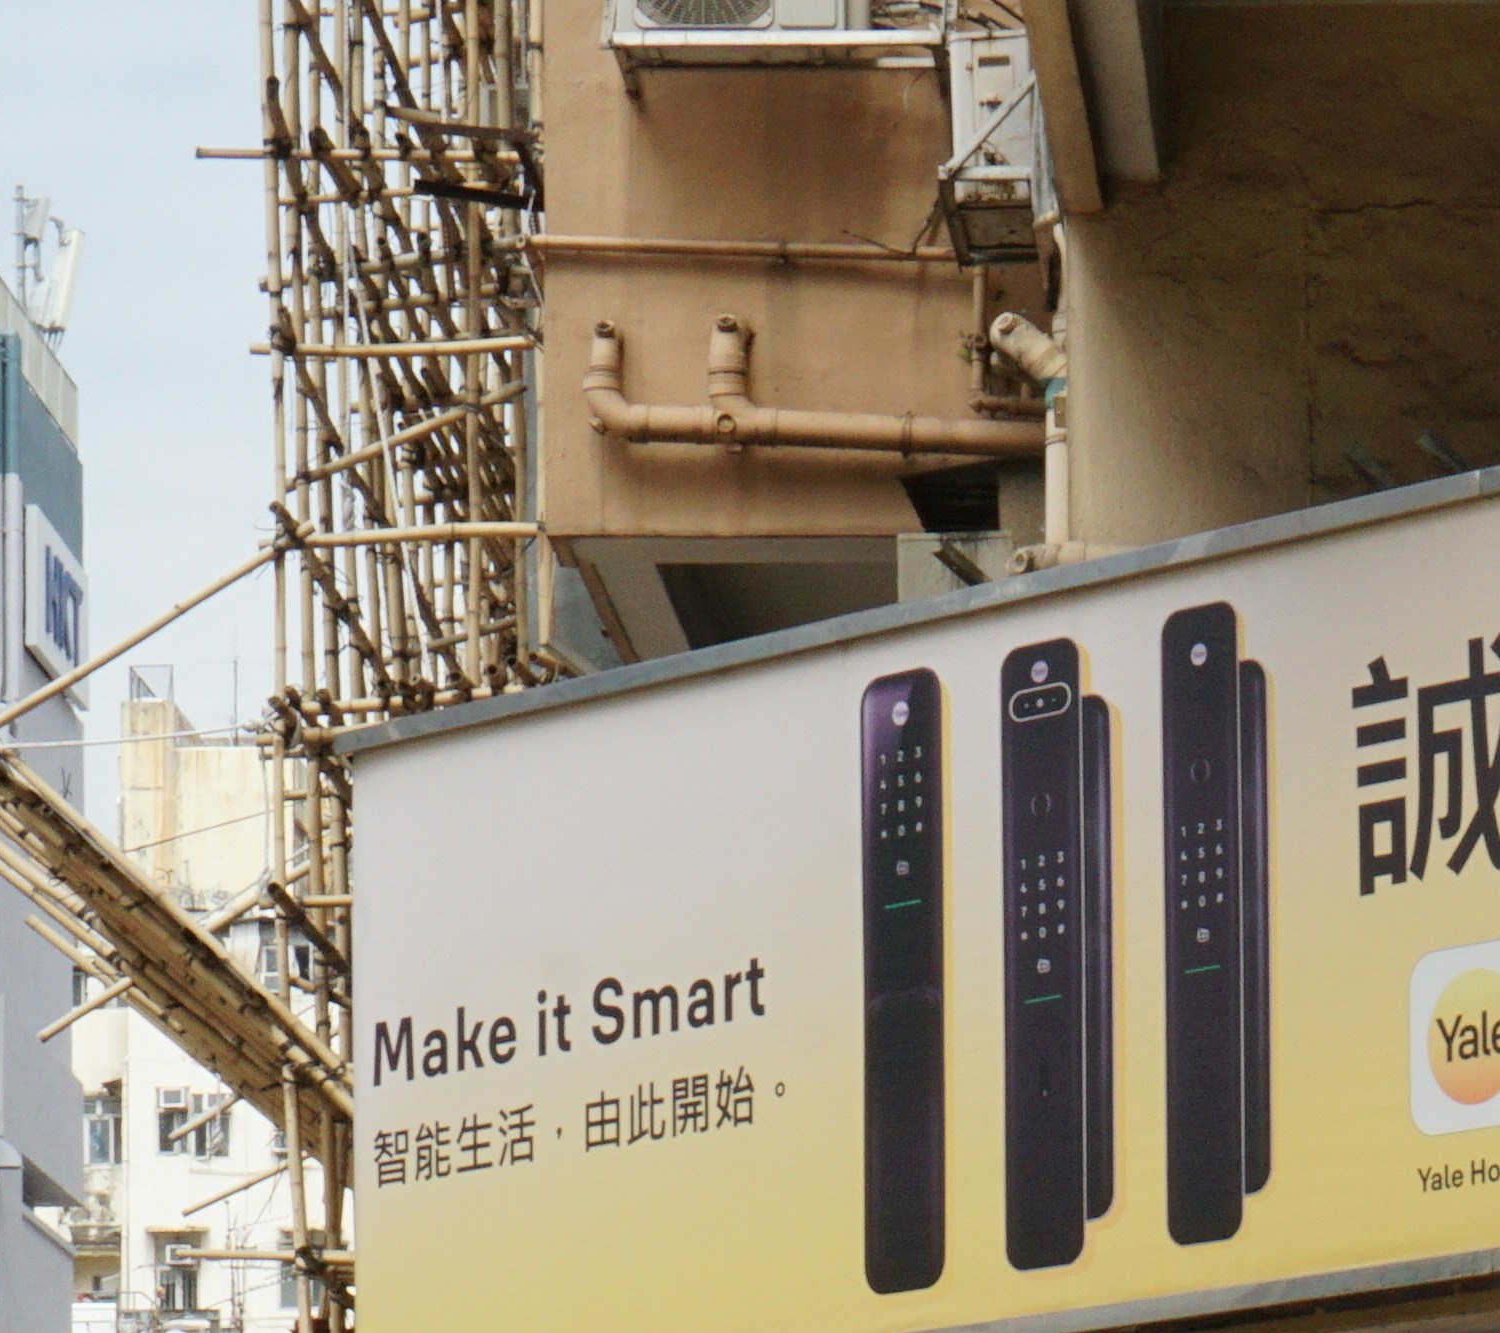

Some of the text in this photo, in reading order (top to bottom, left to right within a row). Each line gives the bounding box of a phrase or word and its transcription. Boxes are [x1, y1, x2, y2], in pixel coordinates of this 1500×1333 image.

[372, 957, 766, 1087] Make it Smart
[1417, 1164, 1464, 1193] Yale
